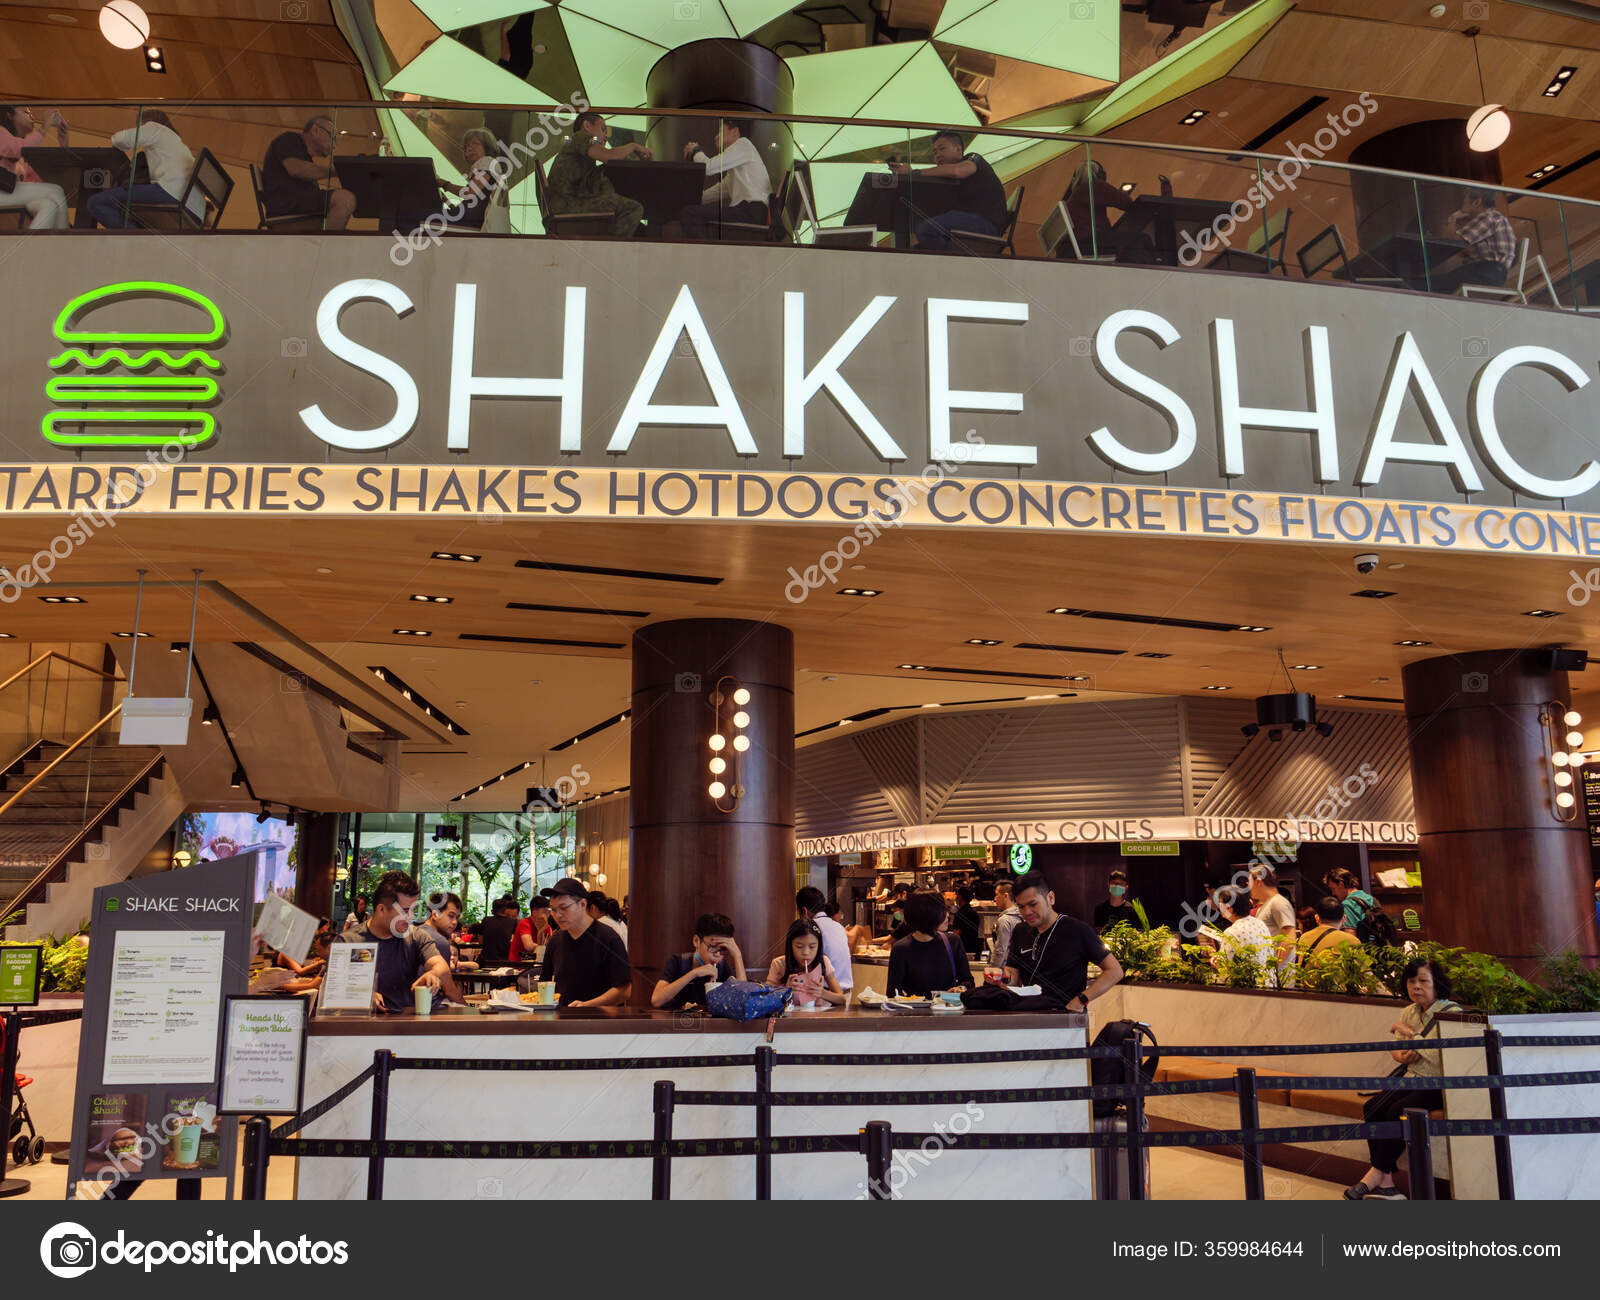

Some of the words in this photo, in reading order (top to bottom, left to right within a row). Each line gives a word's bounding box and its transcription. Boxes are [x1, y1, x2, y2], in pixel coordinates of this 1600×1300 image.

[299, 278, 1038, 465] SHAKE
[1086, 309, 1600, 498] SHAC
[0, 466, 144, 510] TARD
[170, 466, 325, 510] FRIES
[353, 467, 582, 514] SHAKES
[609, 472, 902, 522] HOTDOGS
[927, 480, 1259, 535] CONCRETES
[1282, 496, 1456, 546] FLOATS
[1475, 509, 1600, 556] CONE
[796, 837, 837, 857] OTDOGS
[839, 829, 907, 853] CONCRETES
[956, 823, 1048, 845] FLOATS
[1059, 819, 1154, 842] CONES
[1195, 818, 1290, 841] BURGERS
[1298, 821, 1374, 842] FROZEN
[1379, 823, 1416, 843] CUS
[126, 897, 179, 912] SHAKE
[185, 897, 240, 913] SHACK
